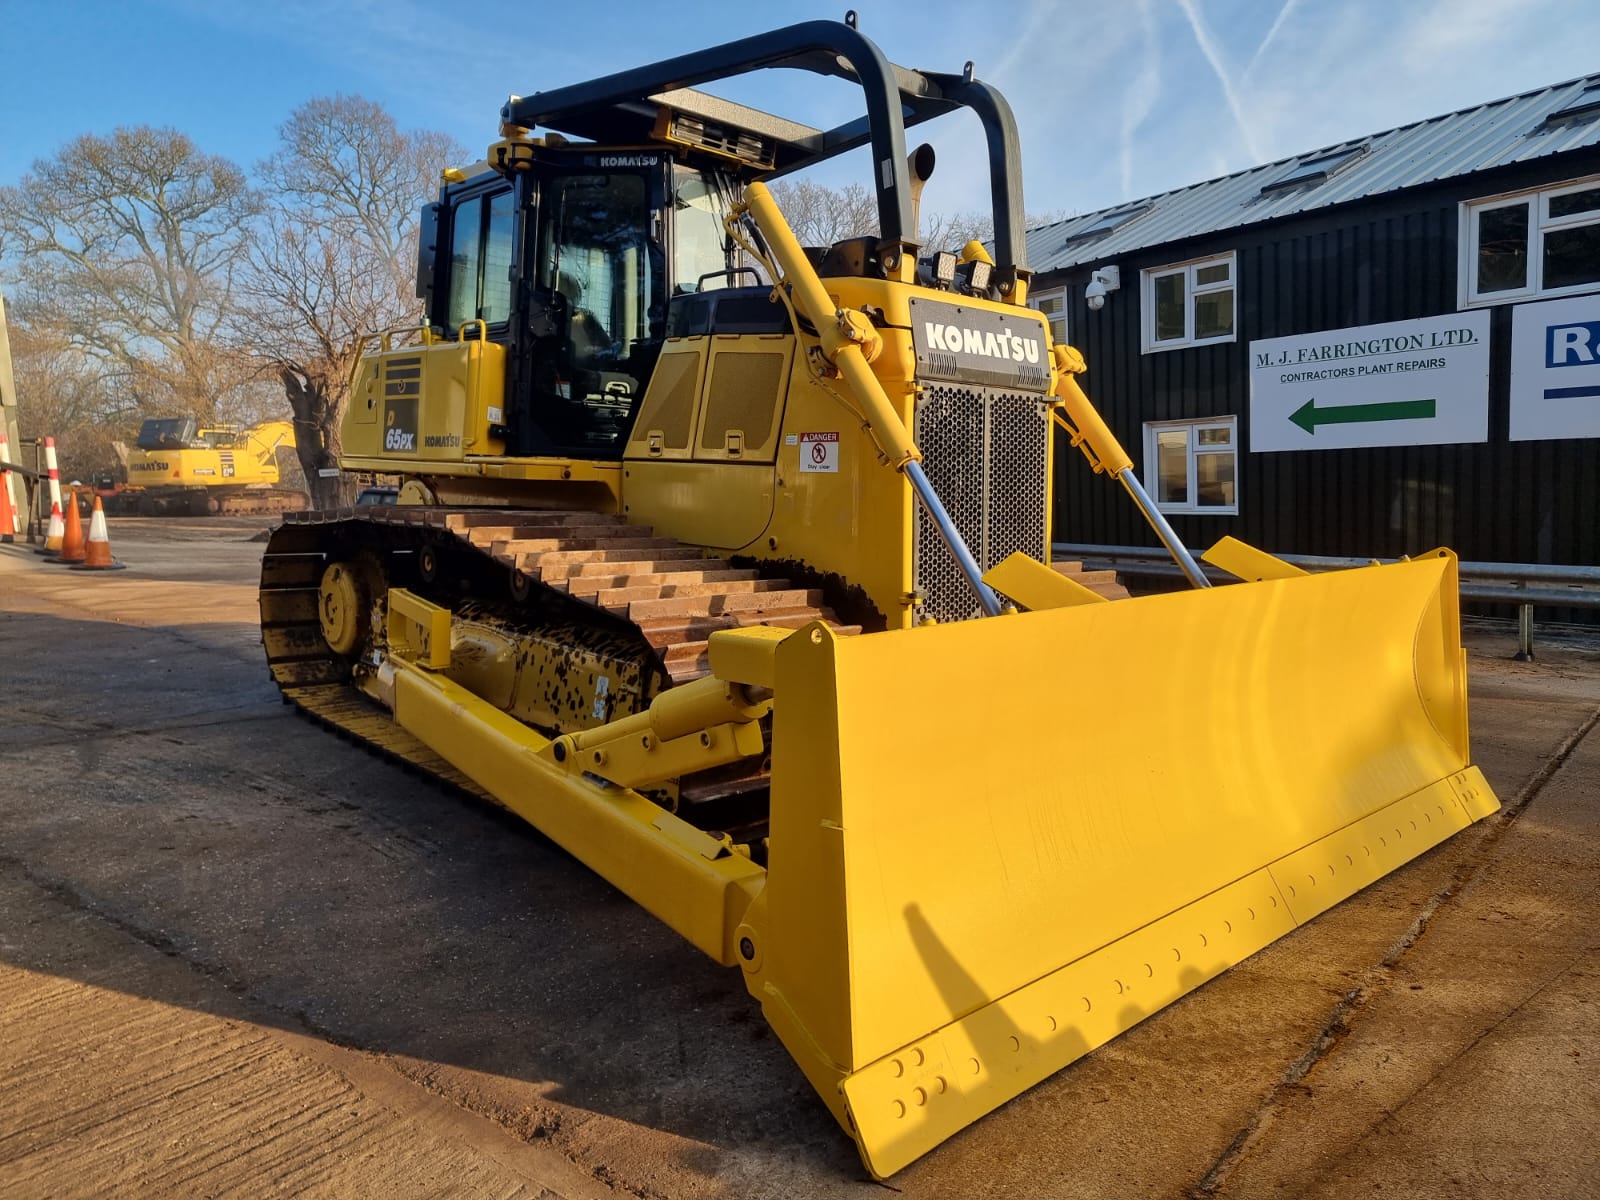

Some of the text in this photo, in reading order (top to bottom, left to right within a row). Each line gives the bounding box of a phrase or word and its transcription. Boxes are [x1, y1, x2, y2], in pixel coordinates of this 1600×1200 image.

[600, 154, 658, 167] KOMATSU
[925, 322, 1039, 364] KOMATSU
[1256, 328, 1478, 367] M. J. FARRINGTON LTD.
[1553, 326, 1600, 364] R
[1280, 358, 1446, 383] CONTRACTORS PLANT REPAIRS
[387, 410, 395, 426] D
[386, 428, 414, 450] 65PX
[424, 433, 461, 448] KOMATSU
[809, 433, 837, 441] DANGER
